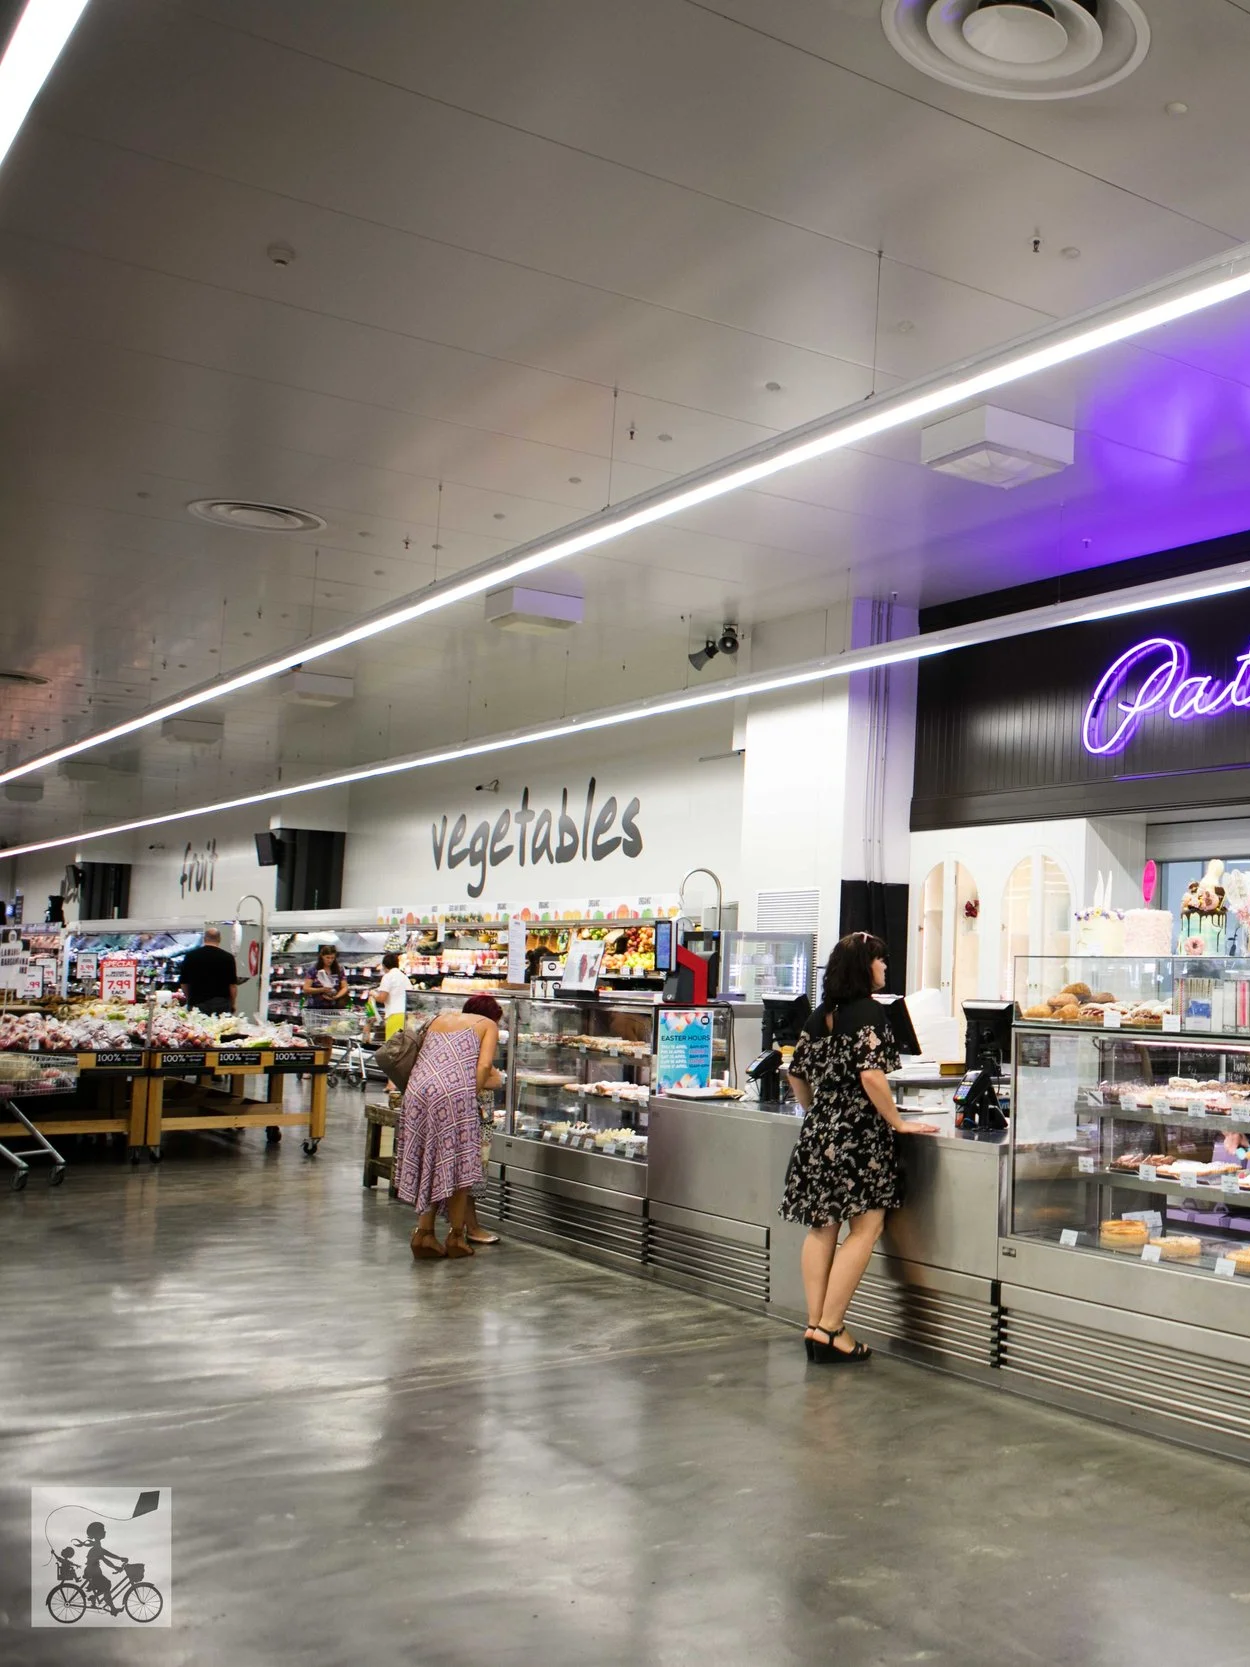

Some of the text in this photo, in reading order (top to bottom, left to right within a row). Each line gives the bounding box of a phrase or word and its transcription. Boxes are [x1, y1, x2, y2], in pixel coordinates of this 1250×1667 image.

[431, 776, 643, 898] vegetables
[180, 838, 219, 899] fruit
[107, 980, 131, 990] 7.99
[97, 1053, 121, 1062] 100%
[162, 1054, 186, 1062] 100%
[219, 1053, 242, 1061] 100%
[275, 1052, 297, 1060] 100%
